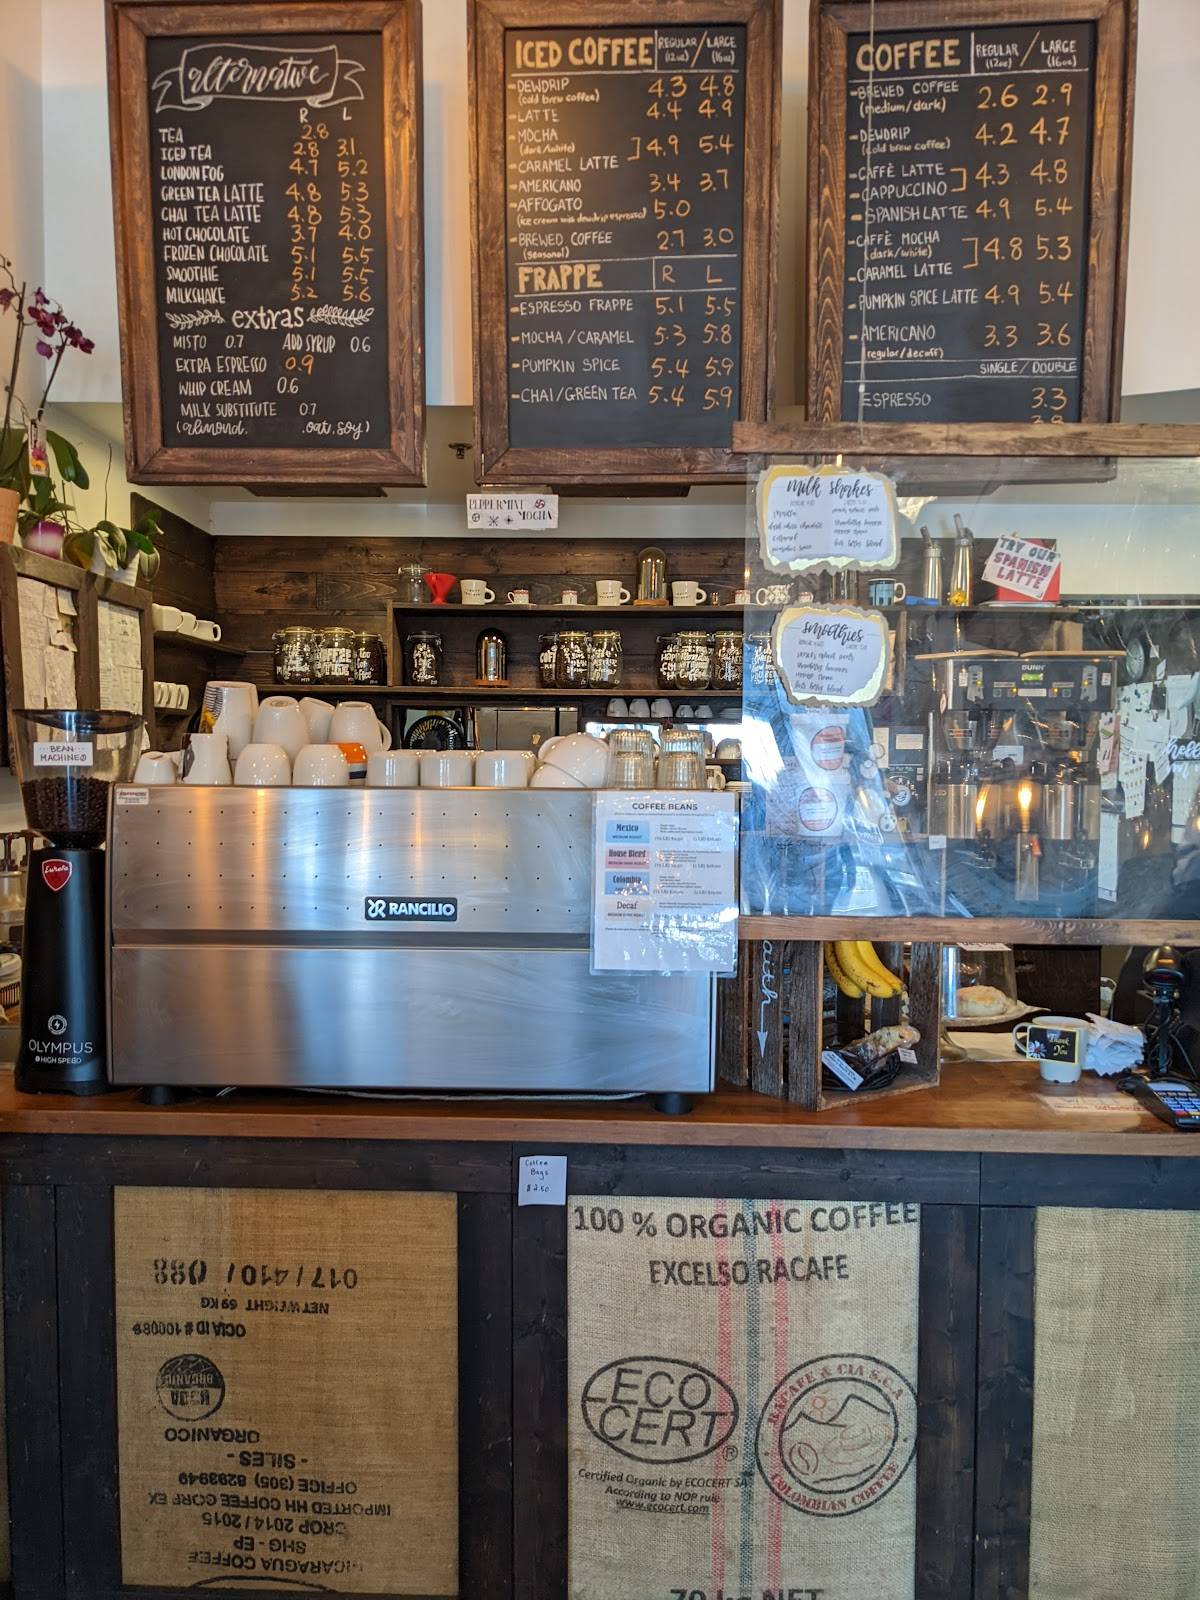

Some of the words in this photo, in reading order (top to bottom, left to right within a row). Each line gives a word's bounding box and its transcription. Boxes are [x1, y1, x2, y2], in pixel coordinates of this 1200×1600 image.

[516, 39, 562, 68] ICED
[568, 37, 653, 65] COFFEE
[658, 37, 697, 48] REGULAR
[707, 37, 736, 48] LARGE
[856, 39, 960, 71] COFFEE
[976, 43, 1018, 57] REGULAR
[1041, 40, 1076, 54] LARGE
[188, 55, 329, 95] alternative
[648, 76, 686, 98] 4.3
[700, 75, 735, 97] 4.8
[913, 81, 959, 94] COFFEE
[978, 84, 1018, 109] 2.6
[1032, 83, 1072, 106] 2.9
[518, 109, 559, 122] LATTE
[647, 102, 681, 120] 4.4
[159, 129, 183, 143] TEA
[519, 129, 558, 141] MOCHA
[975, 122, 1017, 146] 4.2
[1030, 116, 1070, 145] 4.7
[161, 147, 186, 160] ICED
[190, 145, 212, 160] TEA
[699, 134, 734, 155] 5.4
[519, 158, 572, 173] CARAMEL
[580, 156, 618, 170] LATTE
[161, 166, 200, 181] LONDON
[202, 165, 224, 182] FOG
[902, 163, 945, 176] LATTE
[975, 162, 1009, 188] 4.3
[161, 186, 195, 201] GREEN
[197, 186, 220, 201] TEA
[224, 183, 264, 202] LATTE
[519, 179, 581, 193] AMERICANO
[161, 207, 188, 222] CHAI
[194, 206, 219, 222] TEA
[224, 205, 261, 222] LATTE
[866, 205, 919, 223] SPANISH
[923, 206, 968, 219] LATTE
[163, 227, 182, 241] HOT
[185, 226, 250, 242] CHOCOLATE
[519, 233, 565, 246] BREWED
[571, 232, 612, 245] COFFEE
[902, 231, 940, 245] MOCHA
[164, 245, 205, 262] FROZEN
[210, 245, 269, 262] CHOCOLATE
[167, 266, 218, 282] SMOOTHIE
[518, 264, 603, 293] FRAPPE
[663, 265, 675, 283] R
[707, 265, 723, 283] L
[857, 267, 906, 282] CARAMEL
[914, 262, 952, 276] LATTE
[167, 287, 226, 304] MILKSHAKE
[910, 292, 938, 305] SPICE
[943, 289, 978, 304] LATTE
[520, 302, 581, 316] ESPRESSO
[590, 299, 633, 311] FRAPPE
[232, 306, 304, 330] extras
[174, 335, 207, 349] MISTO
[282, 333, 302, 350] ADD
[861, 325, 935, 342] AMERICANO
[176, 358, 211, 373] EXTRA
[522, 359, 575, 373] PUMPKIN
[582, 359, 620, 371] SPICE
[980, 362, 1018, 374] SINGLE
[1032, 362, 1077, 373] DOUBLE
[179, 381, 206, 396] WHIP
[210, 379, 252, 395] CREAM
[612, 387, 637, 400] TEA
[181, 403, 211, 418] MILK
[216, 402, 277, 417] SUBSTITUTE
[469, 499, 523, 510] PEPPERMINT
[518, 511, 552, 521] MOCHA
[1000, 537, 1025, 553] TRY
[1029, 547, 1056, 562] OUR
[994, 552, 1052, 577] SPANISH
[997, 567, 1044, 589] LATTE
[802, 622, 864, 646] smoothies
[616, 824, 639, 832] Mexico
[609, 850, 627, 858] House
[389, 903, 455, 916] RANCILIO
[29, 1039, 93, 1054] OLYMPUS
[574, 1206, 624, 1234] 100
[632, 1213, 657, 1237] %
[666, 1209, 801, 1238] ORGANIC
[811, 1202, 917, 1232] COFFEE
[650, 1260, 749, 1286] EXCELSO
[757, 1255, 849, 1283] RACAFE
[611, 1368, 711, 1410] ECO
[599, 1405, 728, 1447] CERT
[165, 1427, 260, 1443] ORGANICO
[255, 1475, 293, 1491] (305)
[579, 1468, 623, 1482] Certified
[626, 1474, 666, 1487] Organic
[670, 1480, 682, 1488] by
[685, 1478, 731, 1488] ECOCERT
[299, 1481, 357, 1494] OFFICE
[605, 1486, 656, 1502] According
[661, 1493, 671, 1501] to
[675, 1493, 697, 1501] NOP
[221, 1494, 281, 1511] COFFEE
[285, 1501, 308, 1513] HH
[312, 1504, 390, 1516] IMPORTED
[202, 1512, 241, 1526] 2015
[255, 1518, 293, 1533] 2014
[299, 1520, 349, 1536] CROP
[234, 1537, 255, 1549] EP
[269, 1541, 306, 1554] SHG
[188, 1552, 255, 1570] COFFEE
